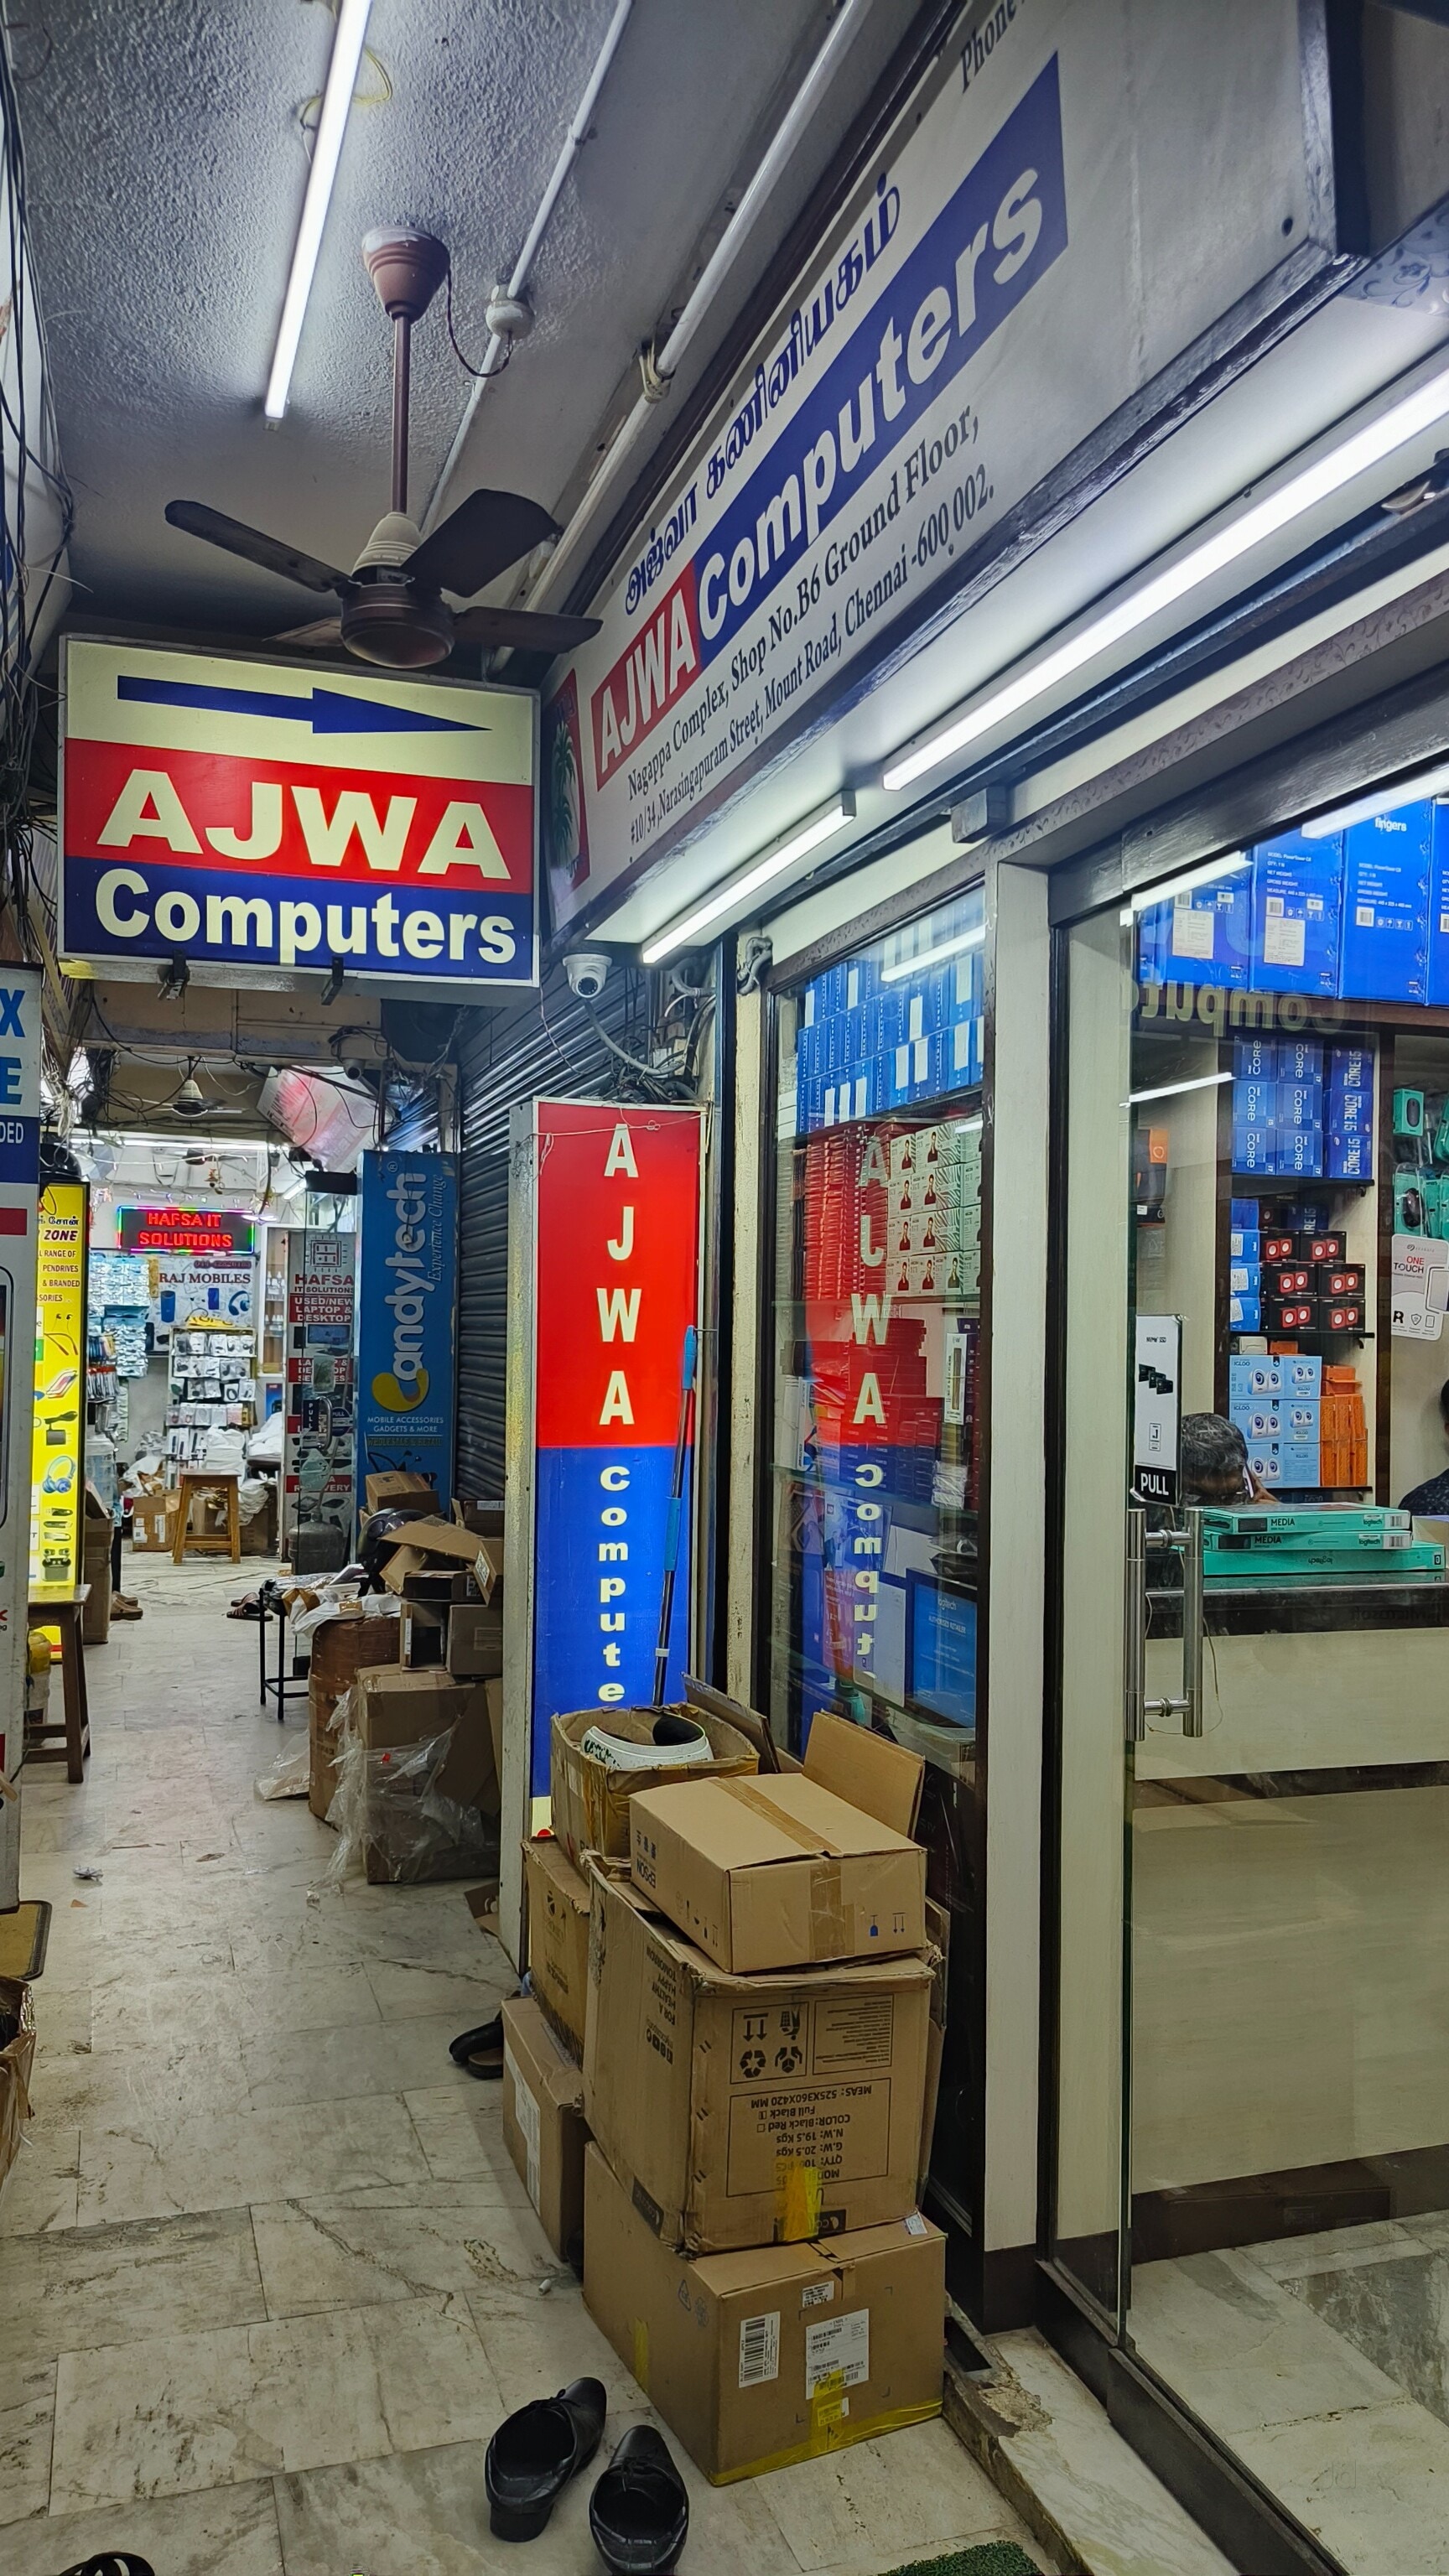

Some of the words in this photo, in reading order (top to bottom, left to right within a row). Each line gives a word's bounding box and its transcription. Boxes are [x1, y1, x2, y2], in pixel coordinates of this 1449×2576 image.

[601, 589, 697, 775] AJWA
[699, 169, 1042, 641] Computers
[628, 740, 672, 801] Nagappa
[673, 680, 729, 752] Complex,
[731, 636, 766, 692] Shop
[825, 470, 901, 586] Ground
[904, 405, 979, 503] Floor,
[730, 699, 764, 753] Street,
[764, 655, 802, 719] Mount
[803, 611, 842, 680] Road,
[844, 543, 908, 637] Chennai
[96, 769, 512, 880] AJWA
[1375, 817, 1407, 833] fingers
[95, 869, 517, 966] Computers
[428, 1174, 447, 1218] Change
[148, 1213, 203, 1227] HAFSA
[206, 1214, 222, 1228] IT
[44, 1229, 78, 1241] ZONE
[139, 1232, 233, 1248] SOLUTIONS
[44, 1249, 66, 1258] RANGE
[427, 1219, 444, 1283] Experience
[1406, 1255, 1425, 1265] ONE
[42, 1265, 79, 1273] PENDRIVES
[1393, 1262, 1425, 1274] TOUCH
[159, 1273, 185, 1284] RAJ
[189, 1273, 252, 1284] MOBILES
[294, 1274, 354, 1285] HAFSA
[596, 1123, 642, 1426] AJWA
[38, 1294, 63, 1302] SORIES
[295, 1306, 340, 1314] LAPTOP
[297, 1314, 351, 1322] DESKTOP
[1140, 1472, 1170, 1496] PULL
[1270, 1518, 1296, 1526] MEDIA
[1254, 1535, 1282, 1545] MEDIA
[636, 1857, 656, 1889] EPSON
[657, 1972, 677, 1996] HAPPY
[652, 1981, 676, 2011] HEALTHY
[663, 2008, 676, 2025] FOR
[841, 2085, 873, 2097] MEAS:
[750, 2097, 769, 2109] MM
[771, 2089, 838, 2106] 525X360X420
[770, 2106, 797, 2119] Black
[798, 2106, 816, 2116] Full
[767, 2121, 787, 2133] Red
[819, 2127, 844, 2139] N.W:
[776, 2132, 794, 2145] Kgs
[797, 2132, 817, 2143] 19.5
[776, 2146, 794, 2157] Kgs
[796, 2144, 817, 2156] 20.5
[820, 2142, 843, 2152] G.W:
[820, 2153, 843, 2165] QTY:
